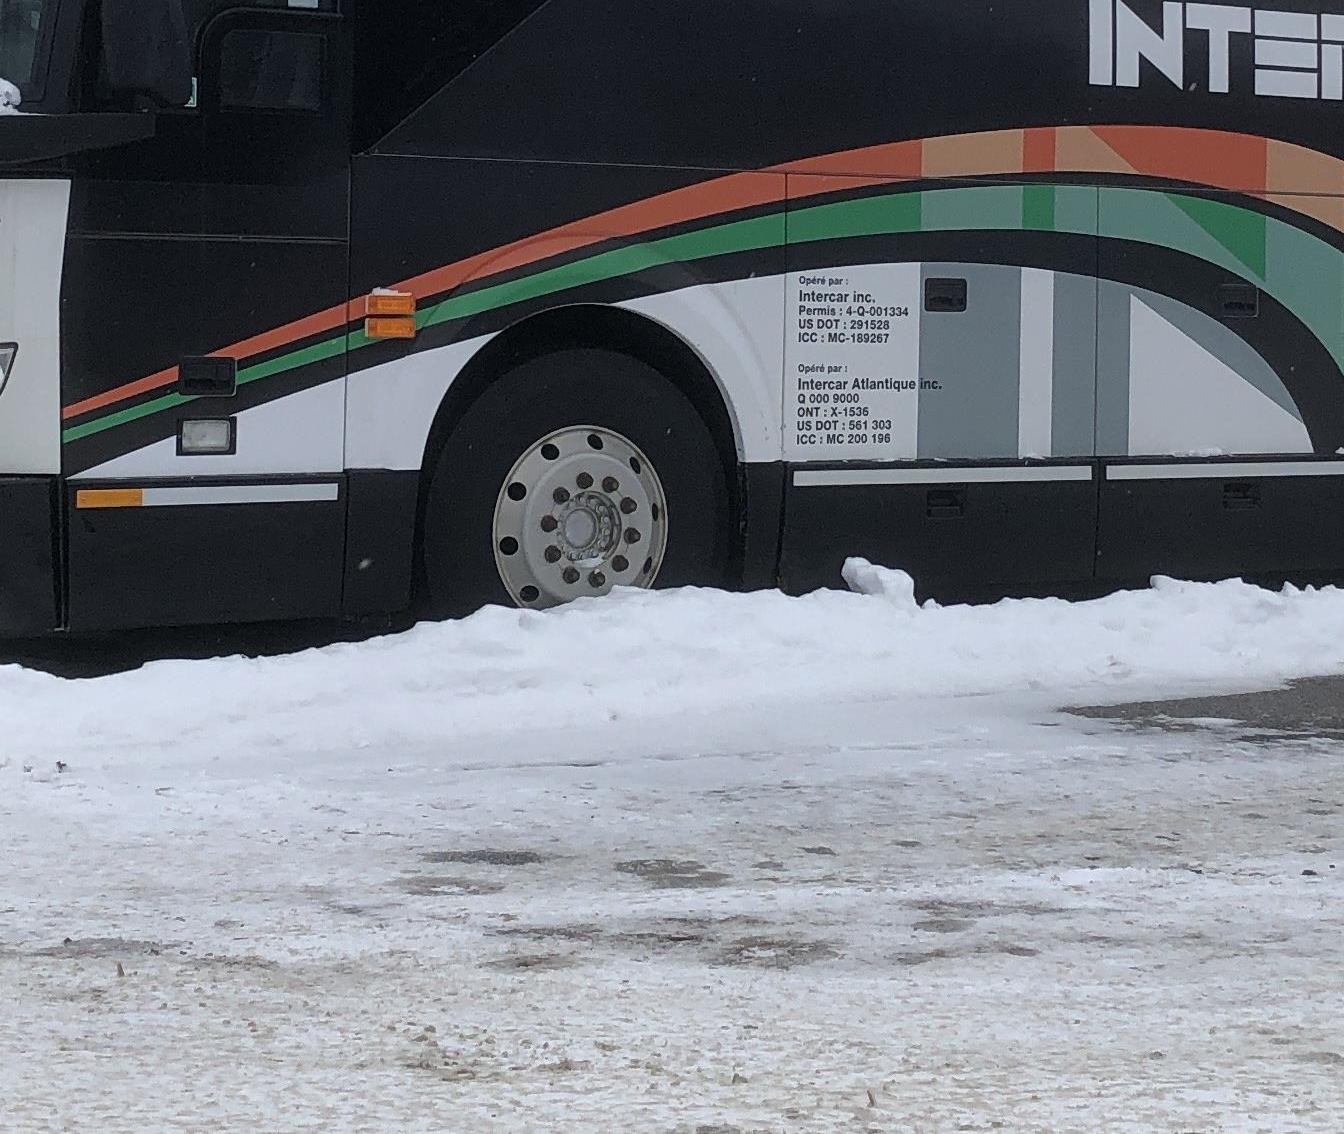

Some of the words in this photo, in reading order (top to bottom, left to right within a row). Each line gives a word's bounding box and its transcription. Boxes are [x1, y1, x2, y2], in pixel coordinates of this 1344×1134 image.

[798, 276, 827, 287] Opéré
[828, 278, 844, 288] par
[798, 290, 850, 303] Intercar
[852, 291, 876, 304] inc.
[798, 305, 837, 317] Permis
[845, 306, 909, 317] 4-Q-001334
[798, 319, 814, 330] US
[816, 319, 841, 330] DOT
[849, 320, 890, 331] 291528
[797, 332, 818, 343] ICC
[827, 333, 890, 344] MC-189267
[797, 364, 826, 375] Opéré
[827, 366, 843, 375] par
[797, 378, 849, 391] Intercar
[852, 378, 917, 394] Atlantique
[919, 378, 943, 390] inc.
[797, 394, 806, 405] Q
[808, 394, 830, 404] 000
[832, 393, 860, 404] 9000
[797, 407, 821, 418] ONT
[796, 421, 813, 432] US
[815, 420, 840, 432] DOT
[848, 420, 868, 431] 561
[871, 420, 892, 431] 303
[796, 434, 817, 445] ICC
[826, 434, 845, 445] MC
[847, 434, 868, 445] 200
[871, 433, 891, 444] 196
